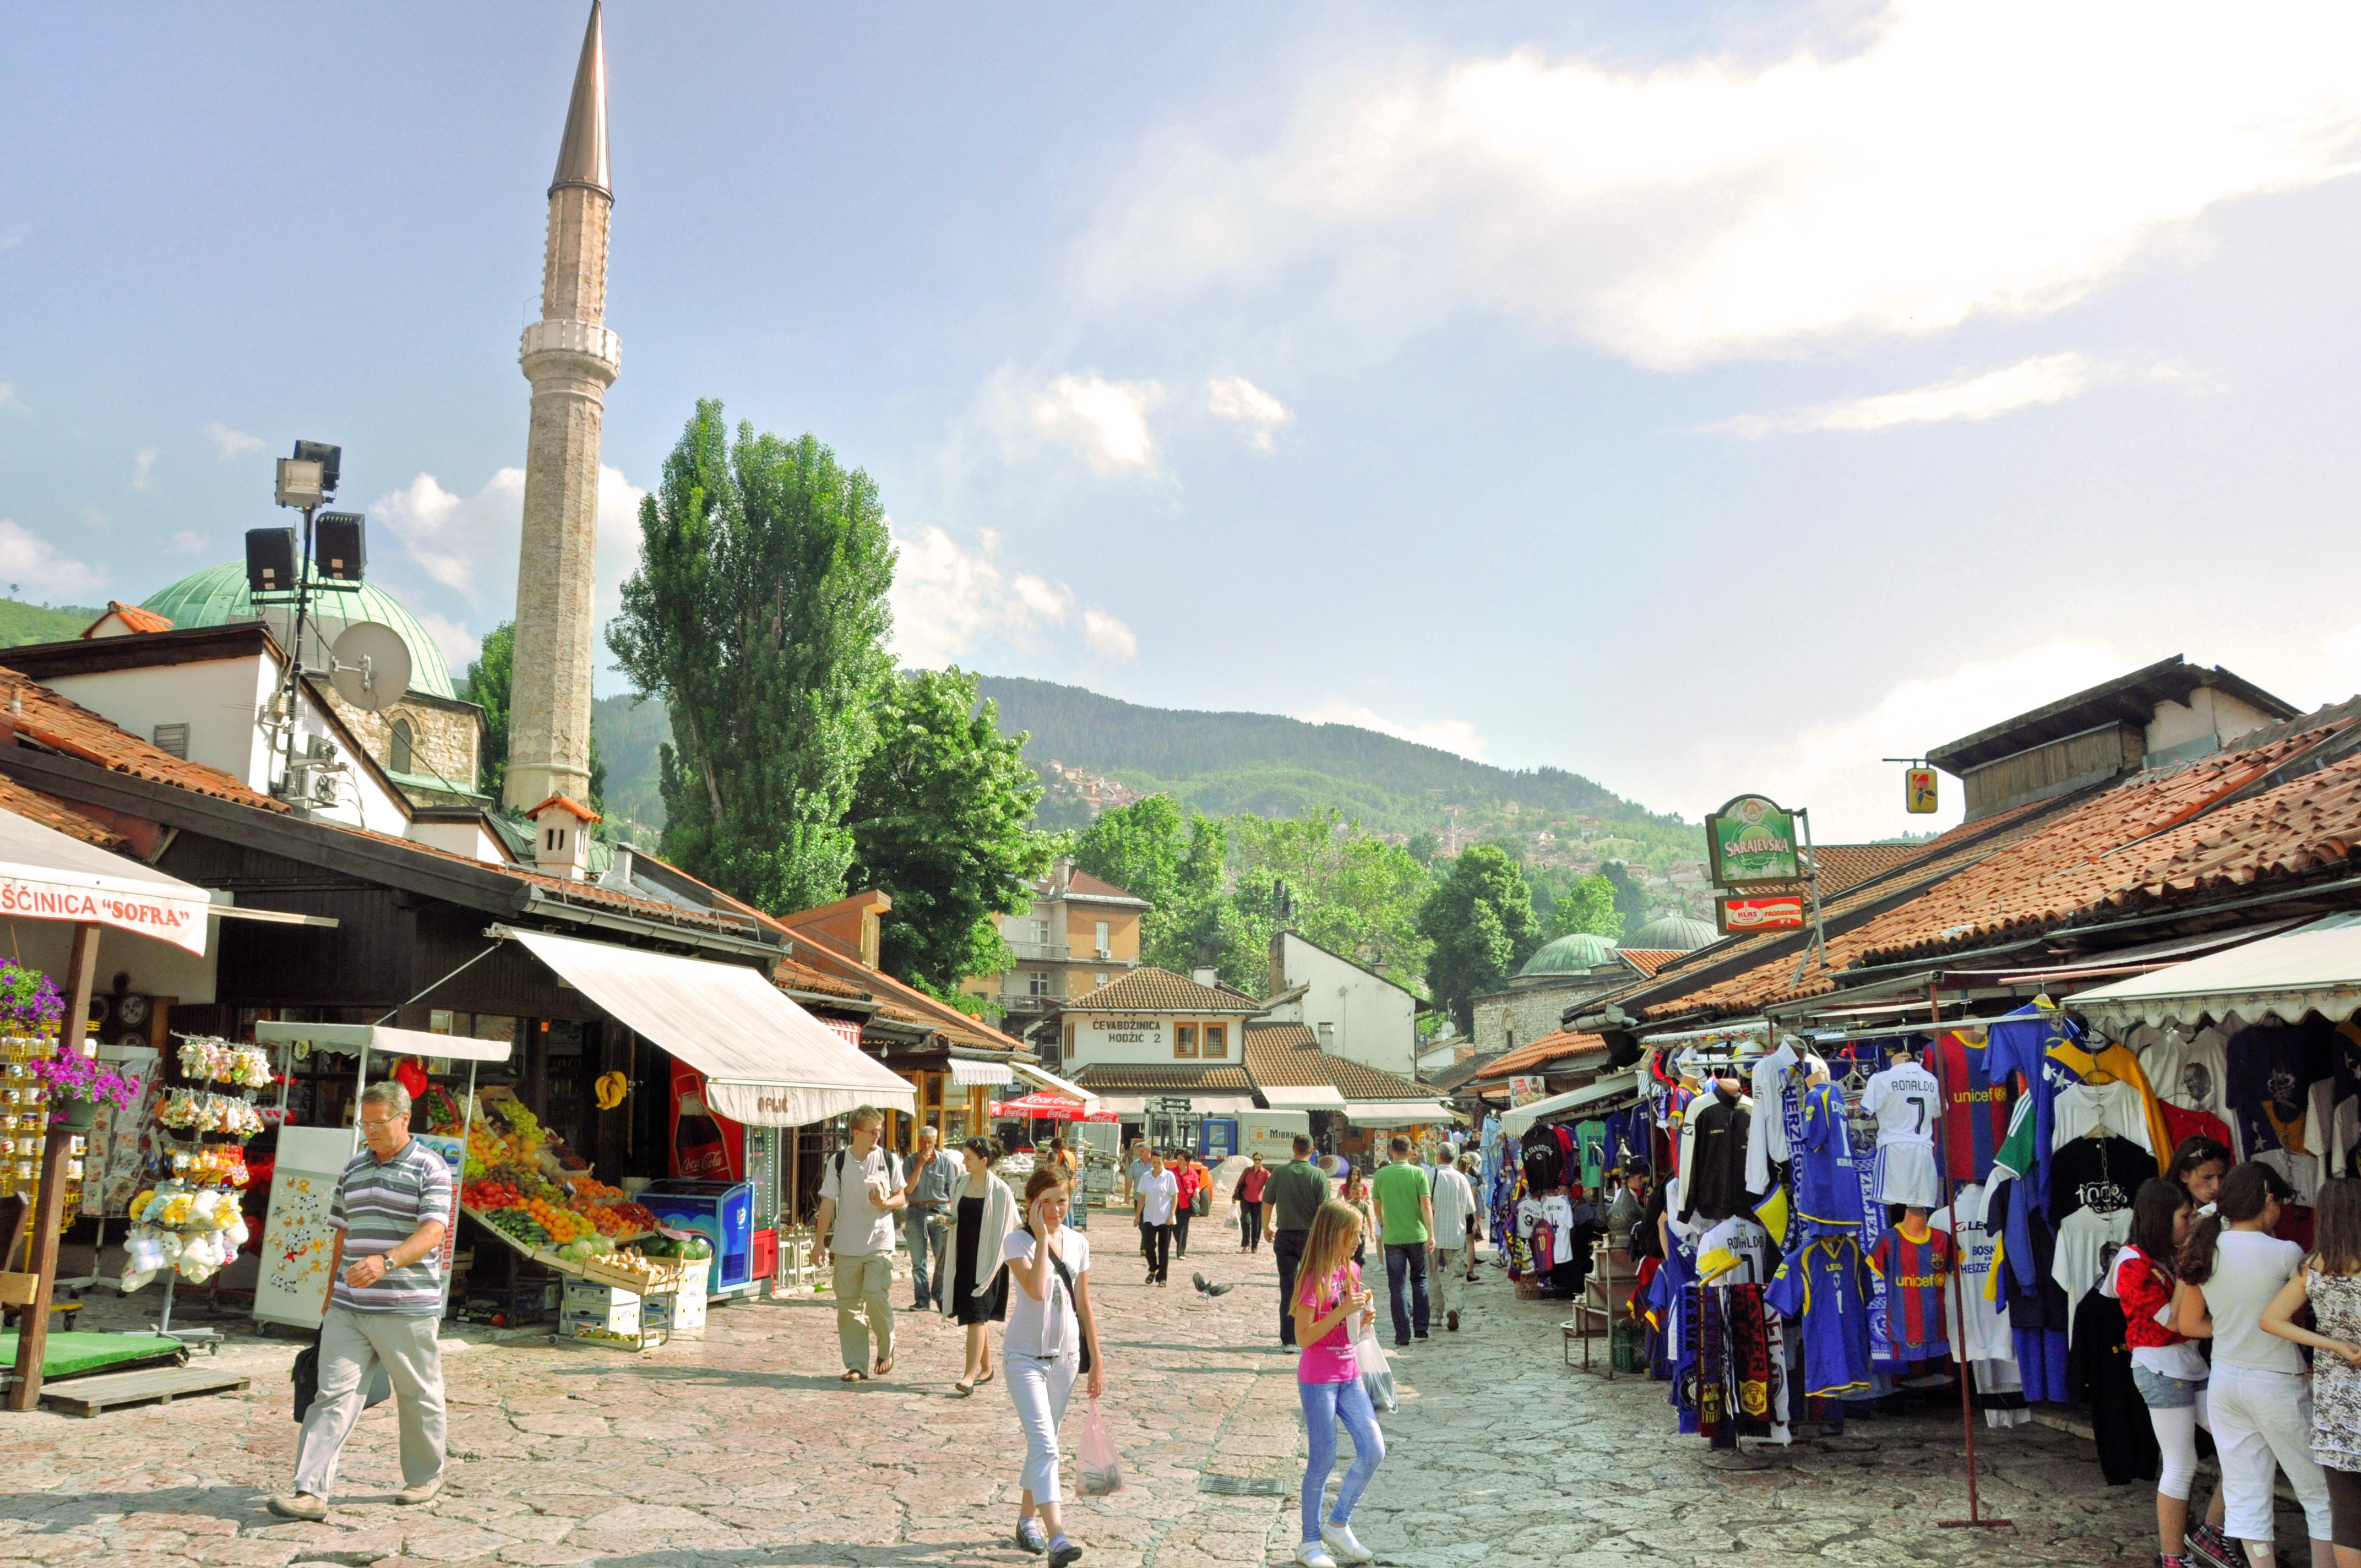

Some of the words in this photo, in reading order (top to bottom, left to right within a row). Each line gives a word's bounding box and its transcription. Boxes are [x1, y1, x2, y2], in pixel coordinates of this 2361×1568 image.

[1724, 837, 1790, 858] SARAJEVSKA
[1, 883, 97, 915] ŠČINICA
[1154, 1033, 1161, 1043] 2
[1891, 1080, 1935, 1093] RONALDO
[1026, 1095, 1081, 1106] Coca-Cola
[1954, 1088, 1994, 1103] unicef
[1004, 1108, 1029, 1117] Coca-Cola
[1047, 1109, 1071, 1119] Coca-Cola
[1089, 1113, 1114, 1123] Coca-Cola
[1906, 1097, 1925, 1135] 7
[681, 1150, 723, 1175] Coca-Cola
[1524, 1214, 1534, 1227] 9
[1972, 1245, 1996, 1256] BOSN
[1895, 1273, 1935, 1287] unicef
